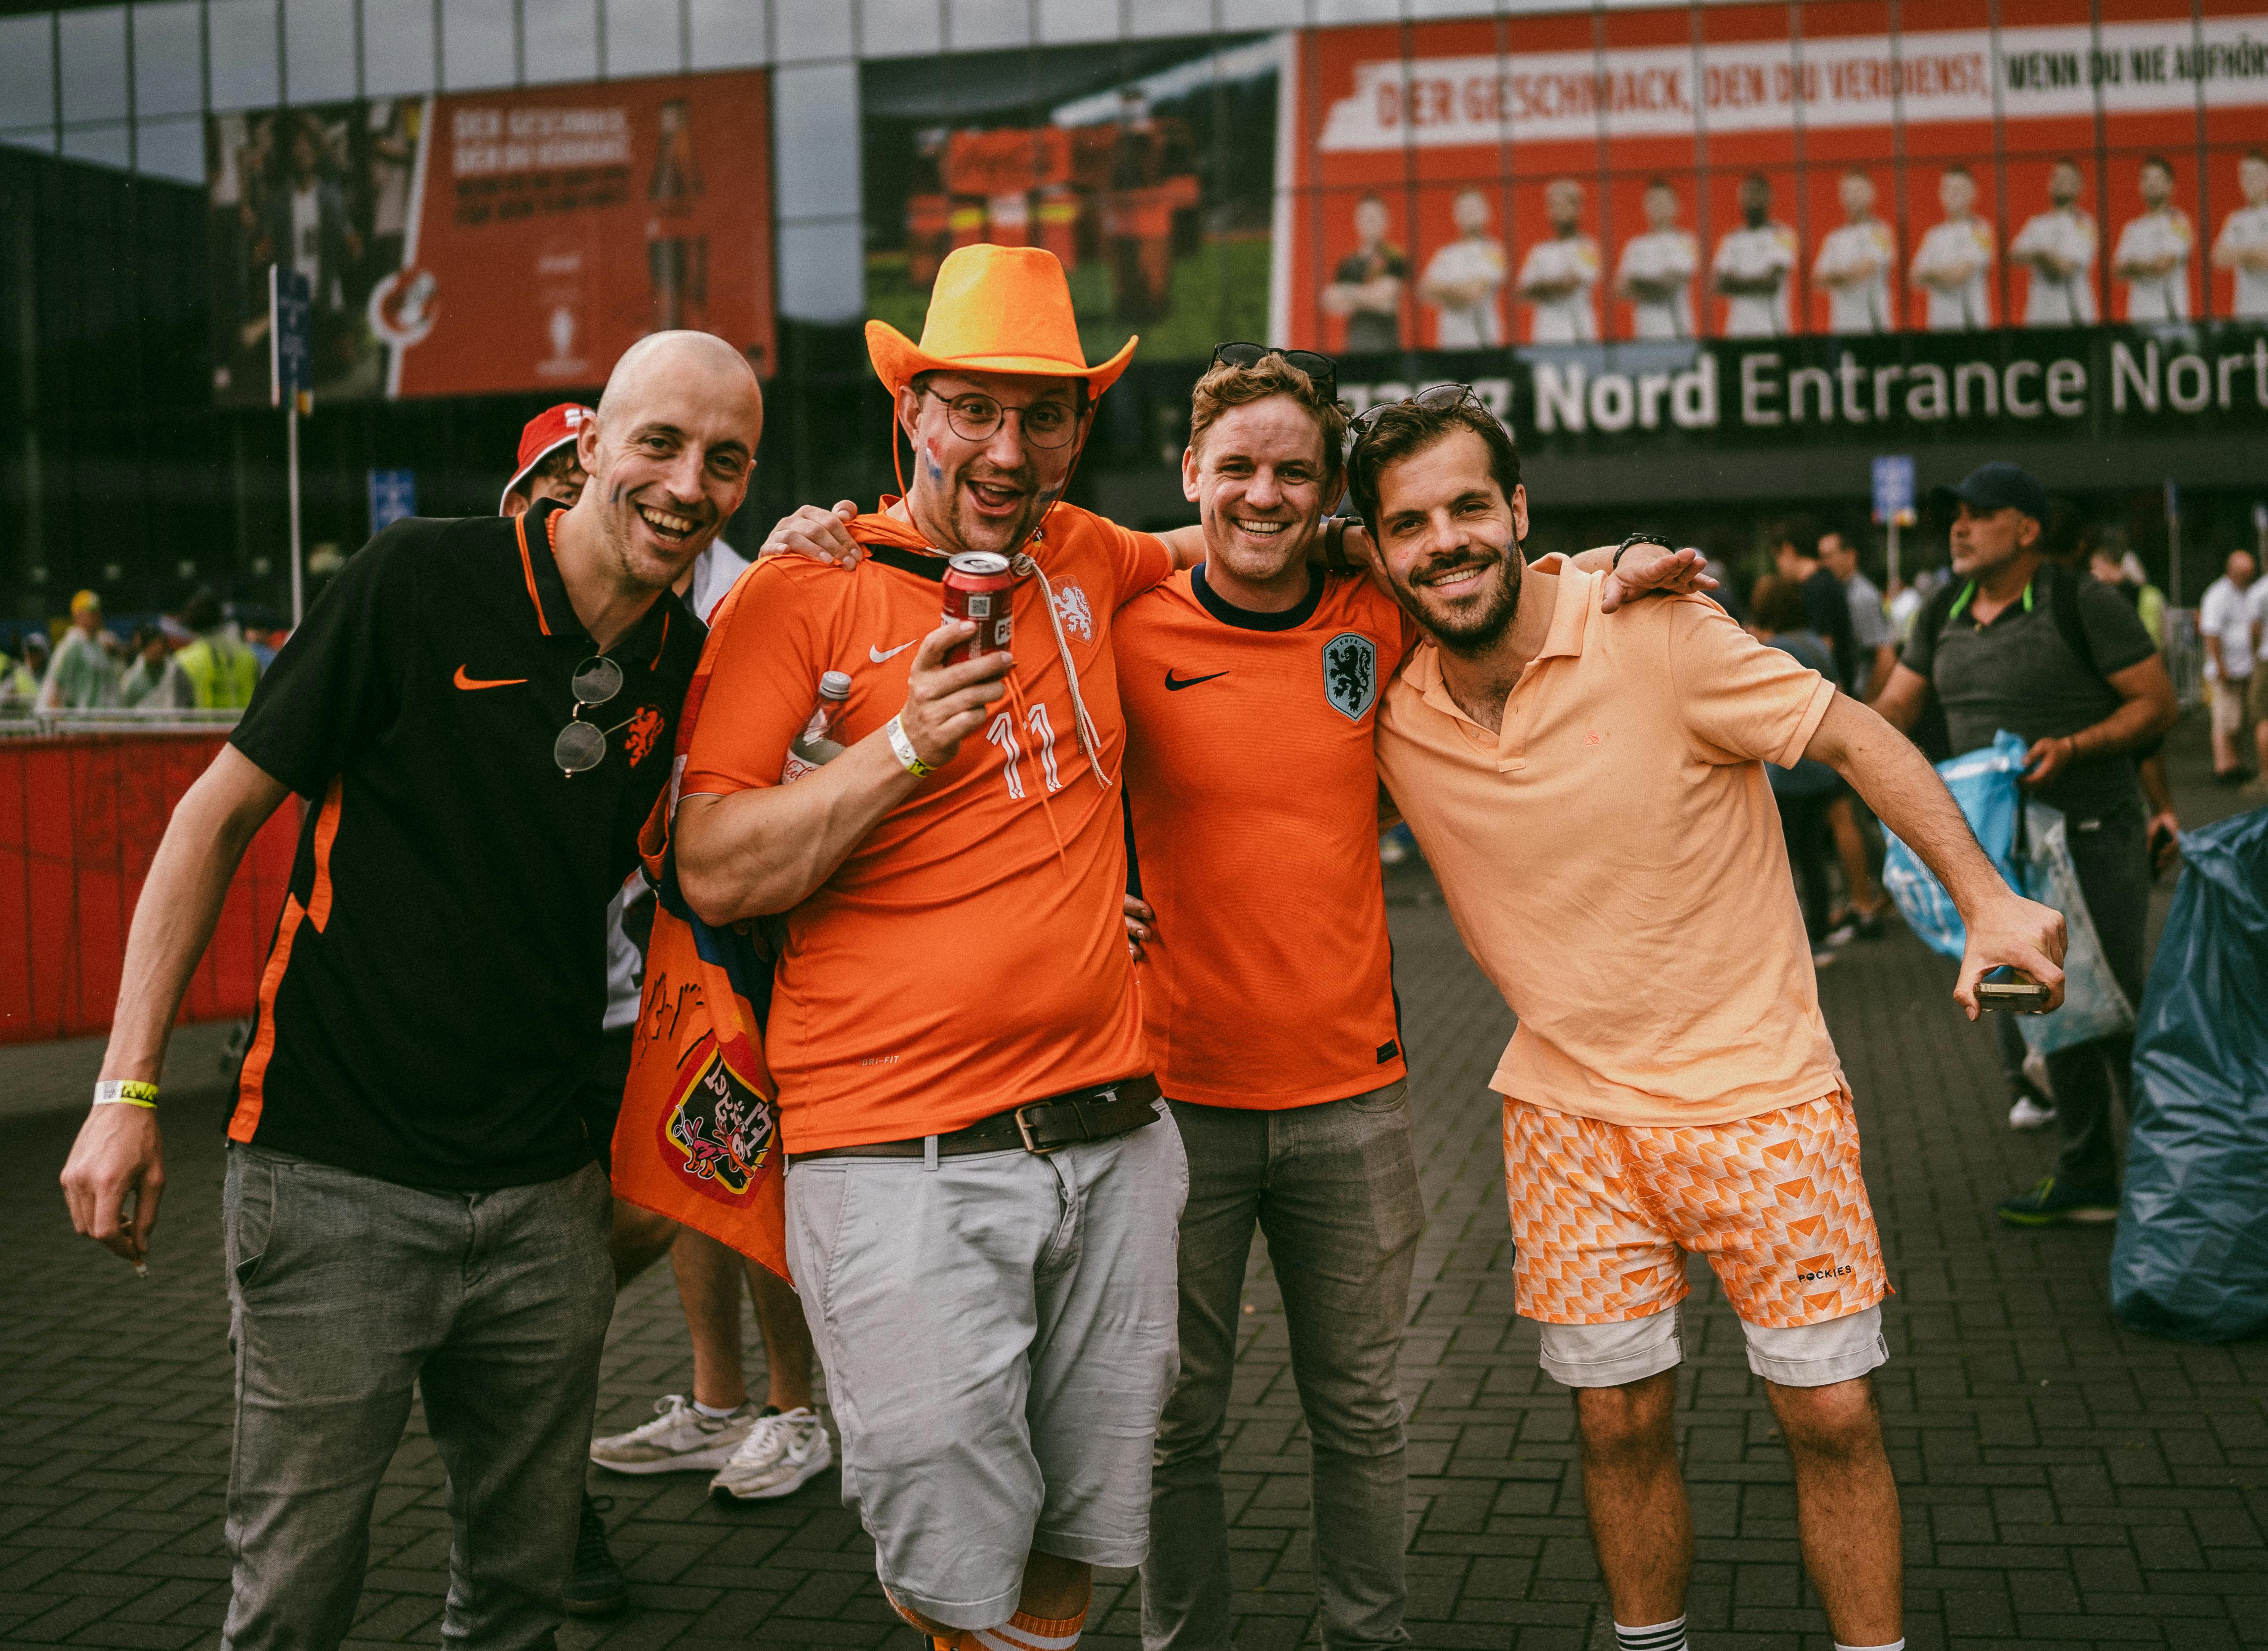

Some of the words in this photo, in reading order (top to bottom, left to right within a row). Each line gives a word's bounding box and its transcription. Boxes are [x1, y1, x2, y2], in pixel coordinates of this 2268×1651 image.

[1378, 77, 1455, 128] DER
[1704, 64, 1765, 108] DEN
[1777, 61, 1818, 103] DU
[2003, 51, 2080, 91] WENN
[2089, 48, 2120, 87] DU
[2131, 44, 2167, 85] NIE
[1535, 351, 1719, 433] Nord
[1741, 350, 2087, 425] Entrance
[986, 703, 1062, 799] 11
[861, 1055, 900, 1066] DRI-FIT
[1798, 1265, 1852, 1283] POCKIES
